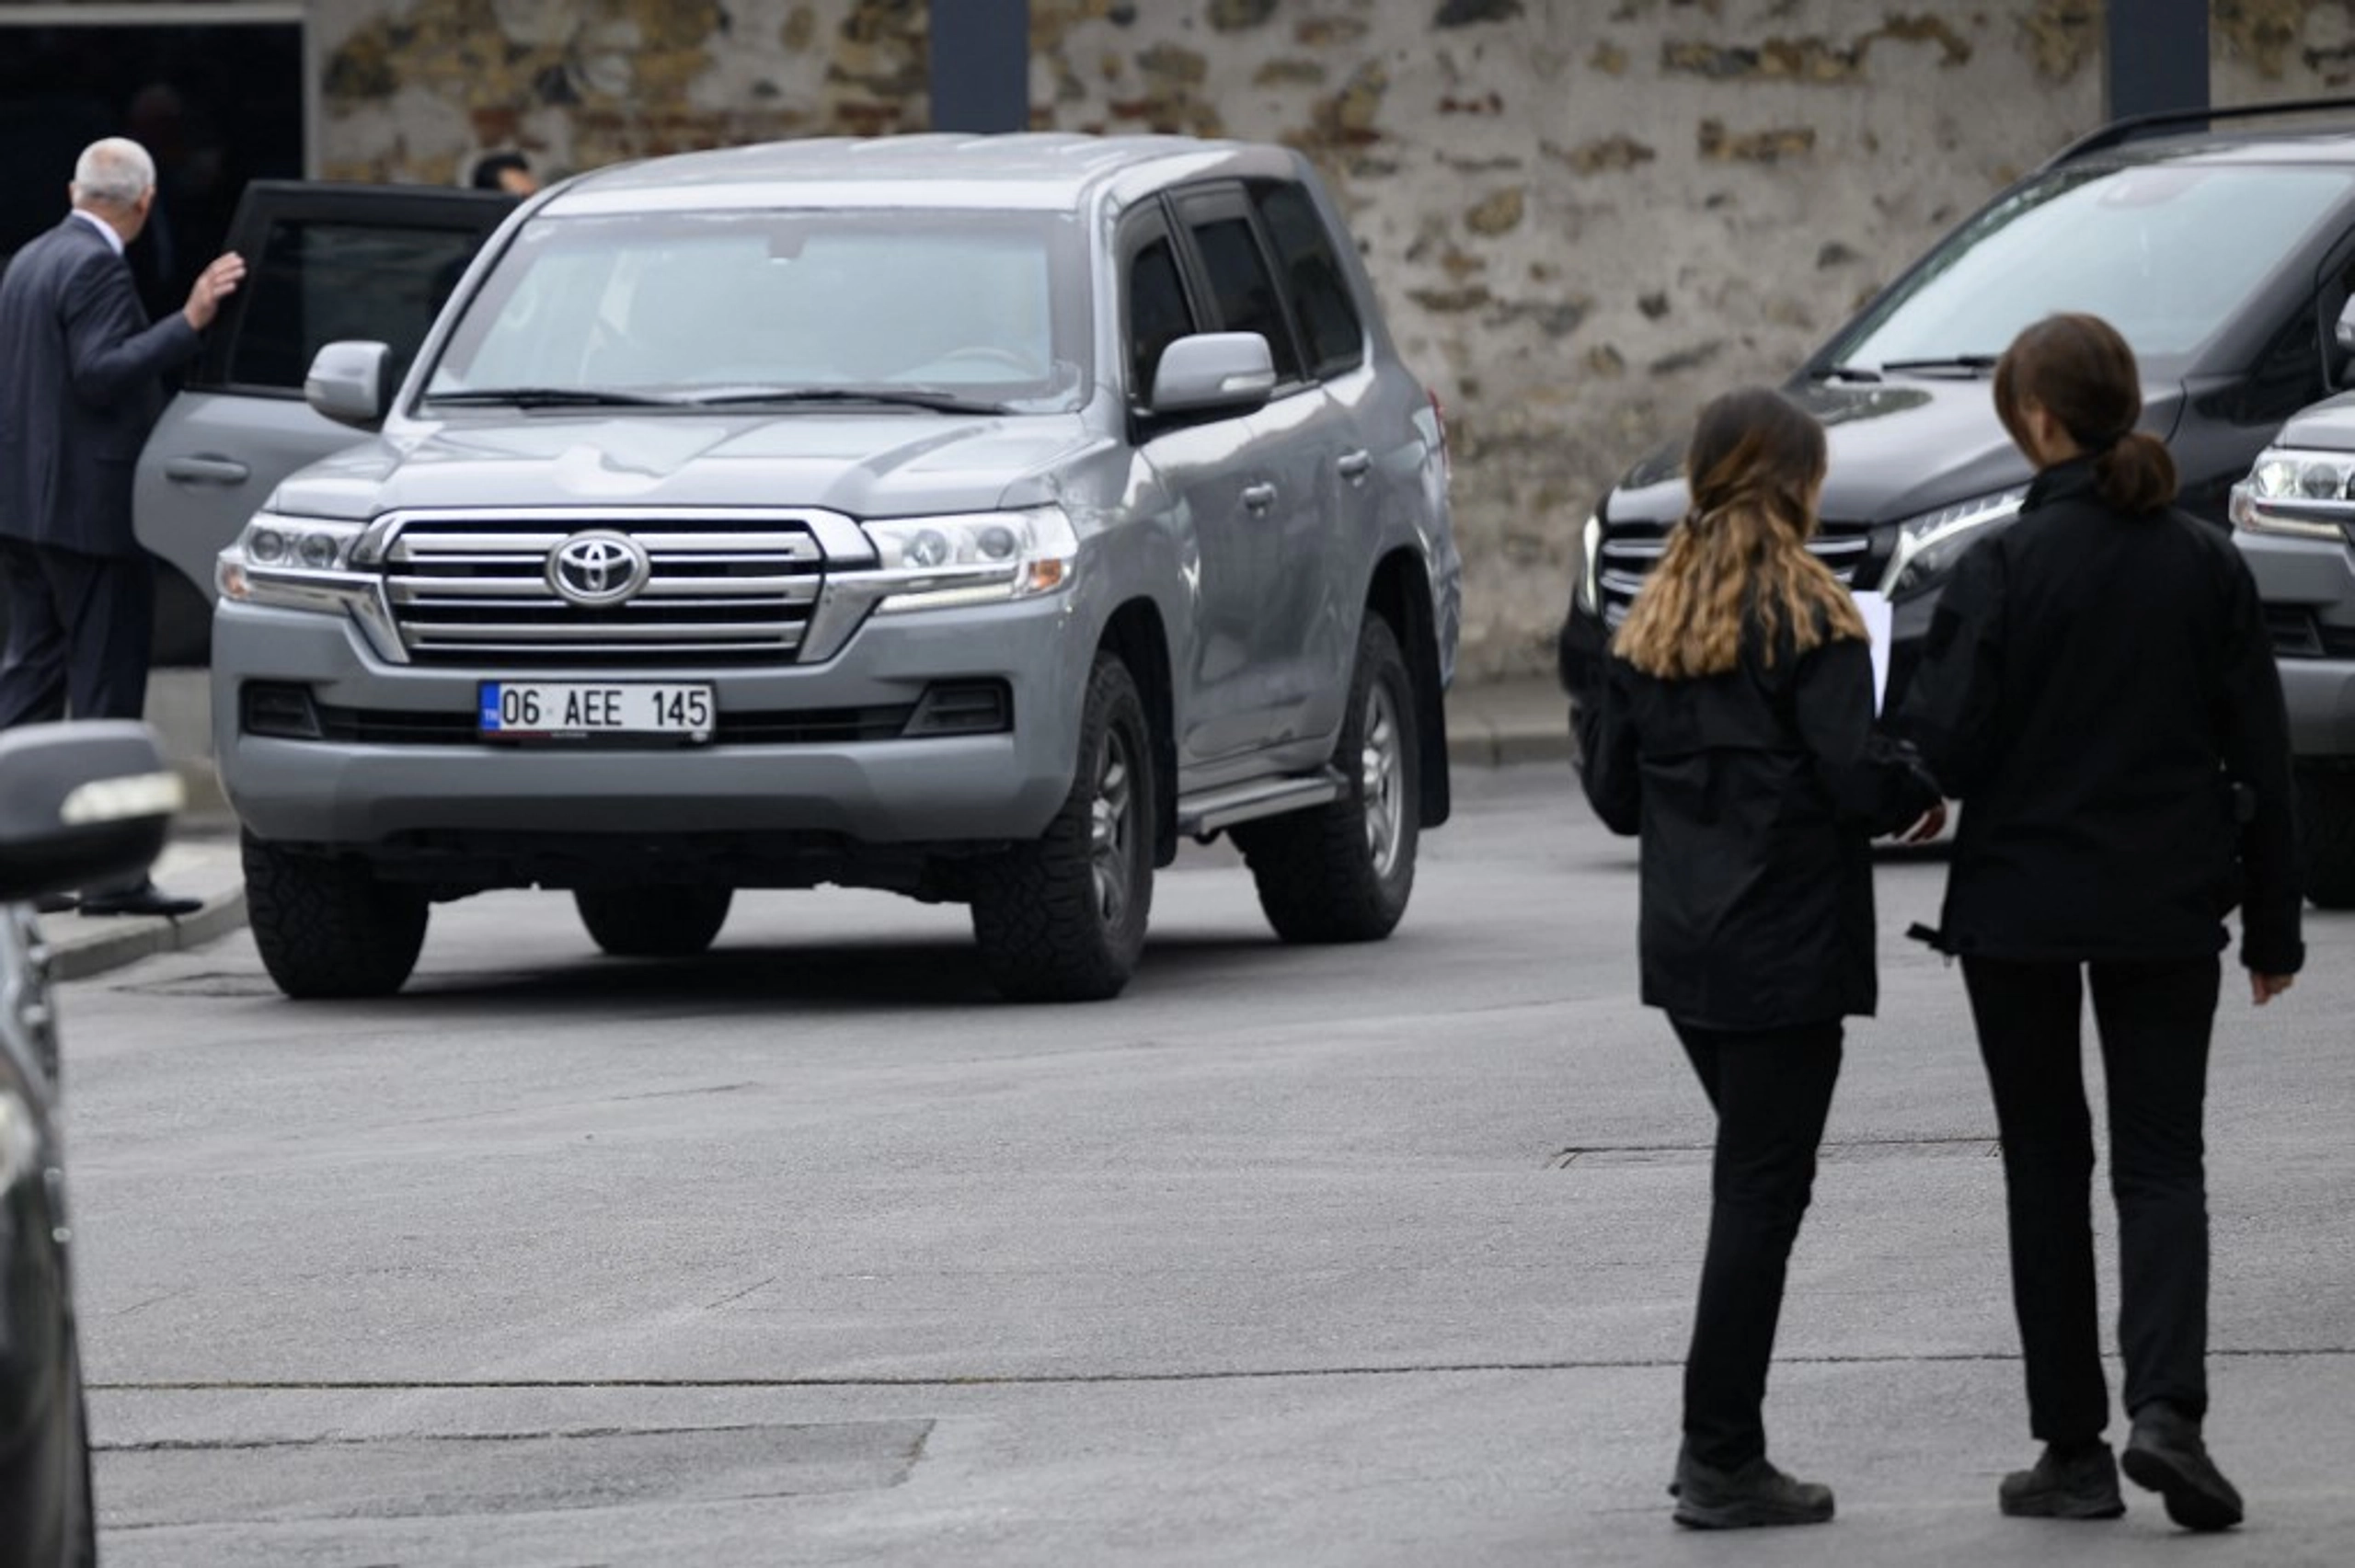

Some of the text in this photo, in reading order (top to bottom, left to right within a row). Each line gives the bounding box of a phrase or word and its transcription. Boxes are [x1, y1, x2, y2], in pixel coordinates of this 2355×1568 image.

[503, 689, 707, 727] 06 AEE 145
